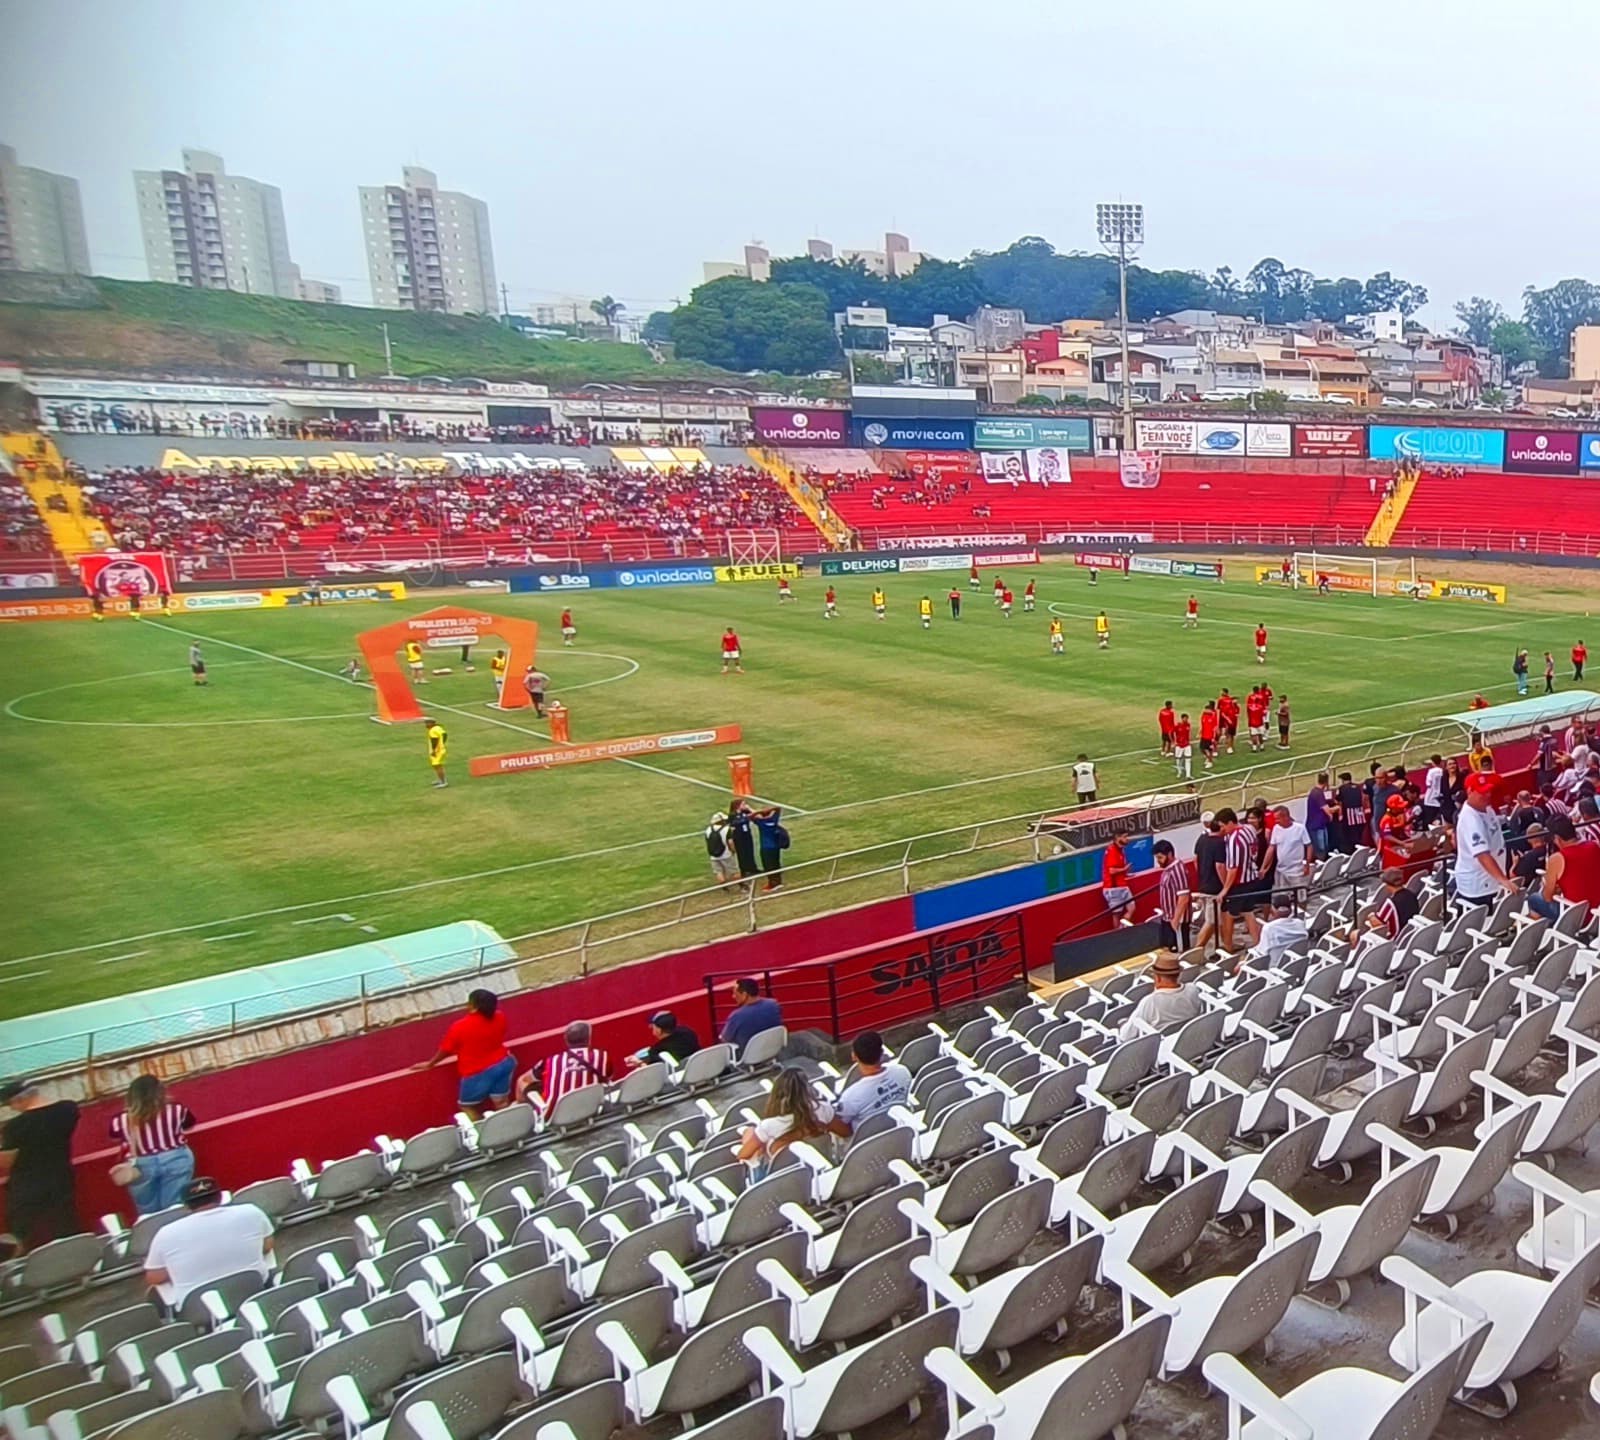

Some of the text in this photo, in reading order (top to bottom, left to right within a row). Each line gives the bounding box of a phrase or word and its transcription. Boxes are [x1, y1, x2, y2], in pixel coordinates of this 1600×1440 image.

[763, 427, 841, 441] uniodonto
[892, 429, 965, 441] moviecom
[1141, 431, 1164, 442] TEM
[1511, 449, 1572, 463] uniodonto
[740, 564, 794, 577] FUEL
[842, 559, 897, 571] DELPHOS
[561, 574, 590, 586] Boa
[635, 570, 713, 585] uniodonto
[302, 588, 378, 600] VDA CAP
[1449, 586, 1489, 598] VIDA CAP
[500, 753, 554, 769] PAULISTA
[1138, 799, 1199, 830] DPLOMATA
